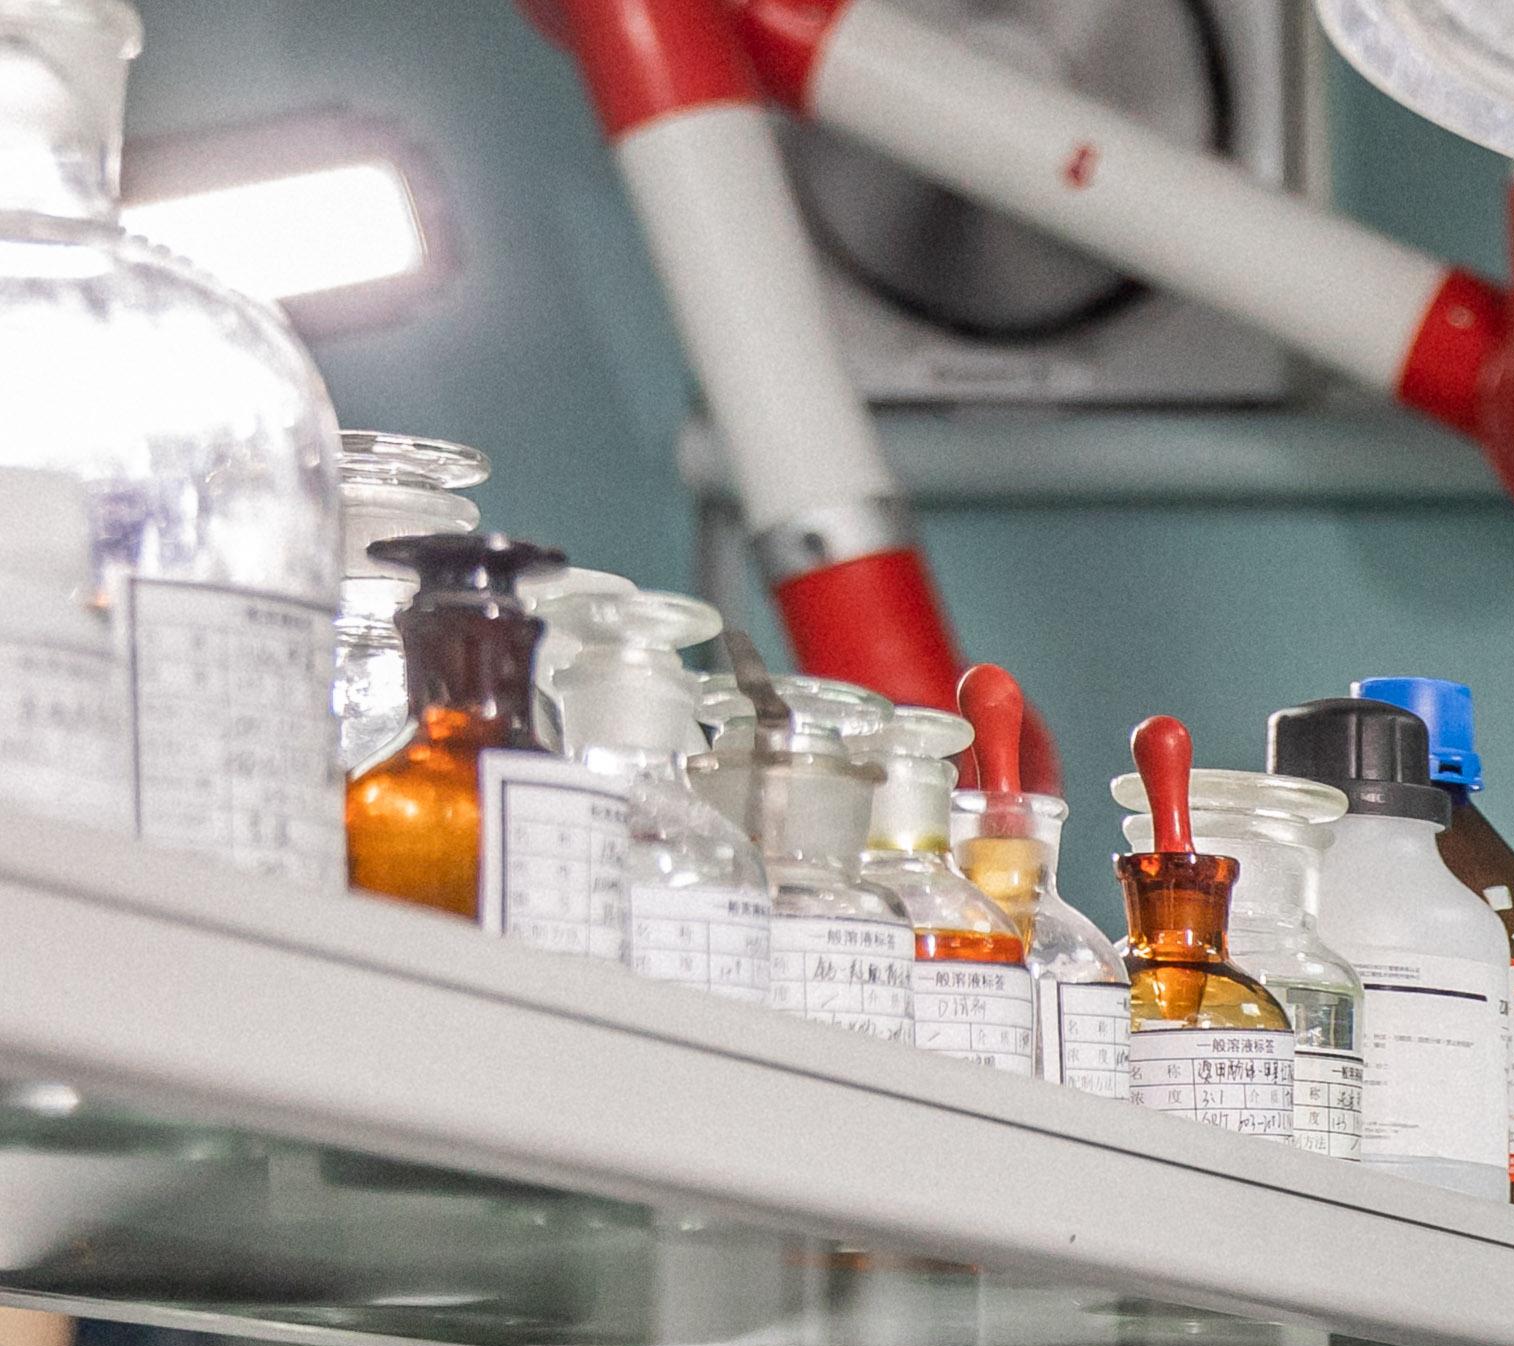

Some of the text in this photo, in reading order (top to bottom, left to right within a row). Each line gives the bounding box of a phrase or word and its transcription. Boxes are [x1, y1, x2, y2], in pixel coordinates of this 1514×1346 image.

[918, 972, 1005, 991] 一般溶液标签
[1197, 1038, 1275, 1054] 一般溶液标签
